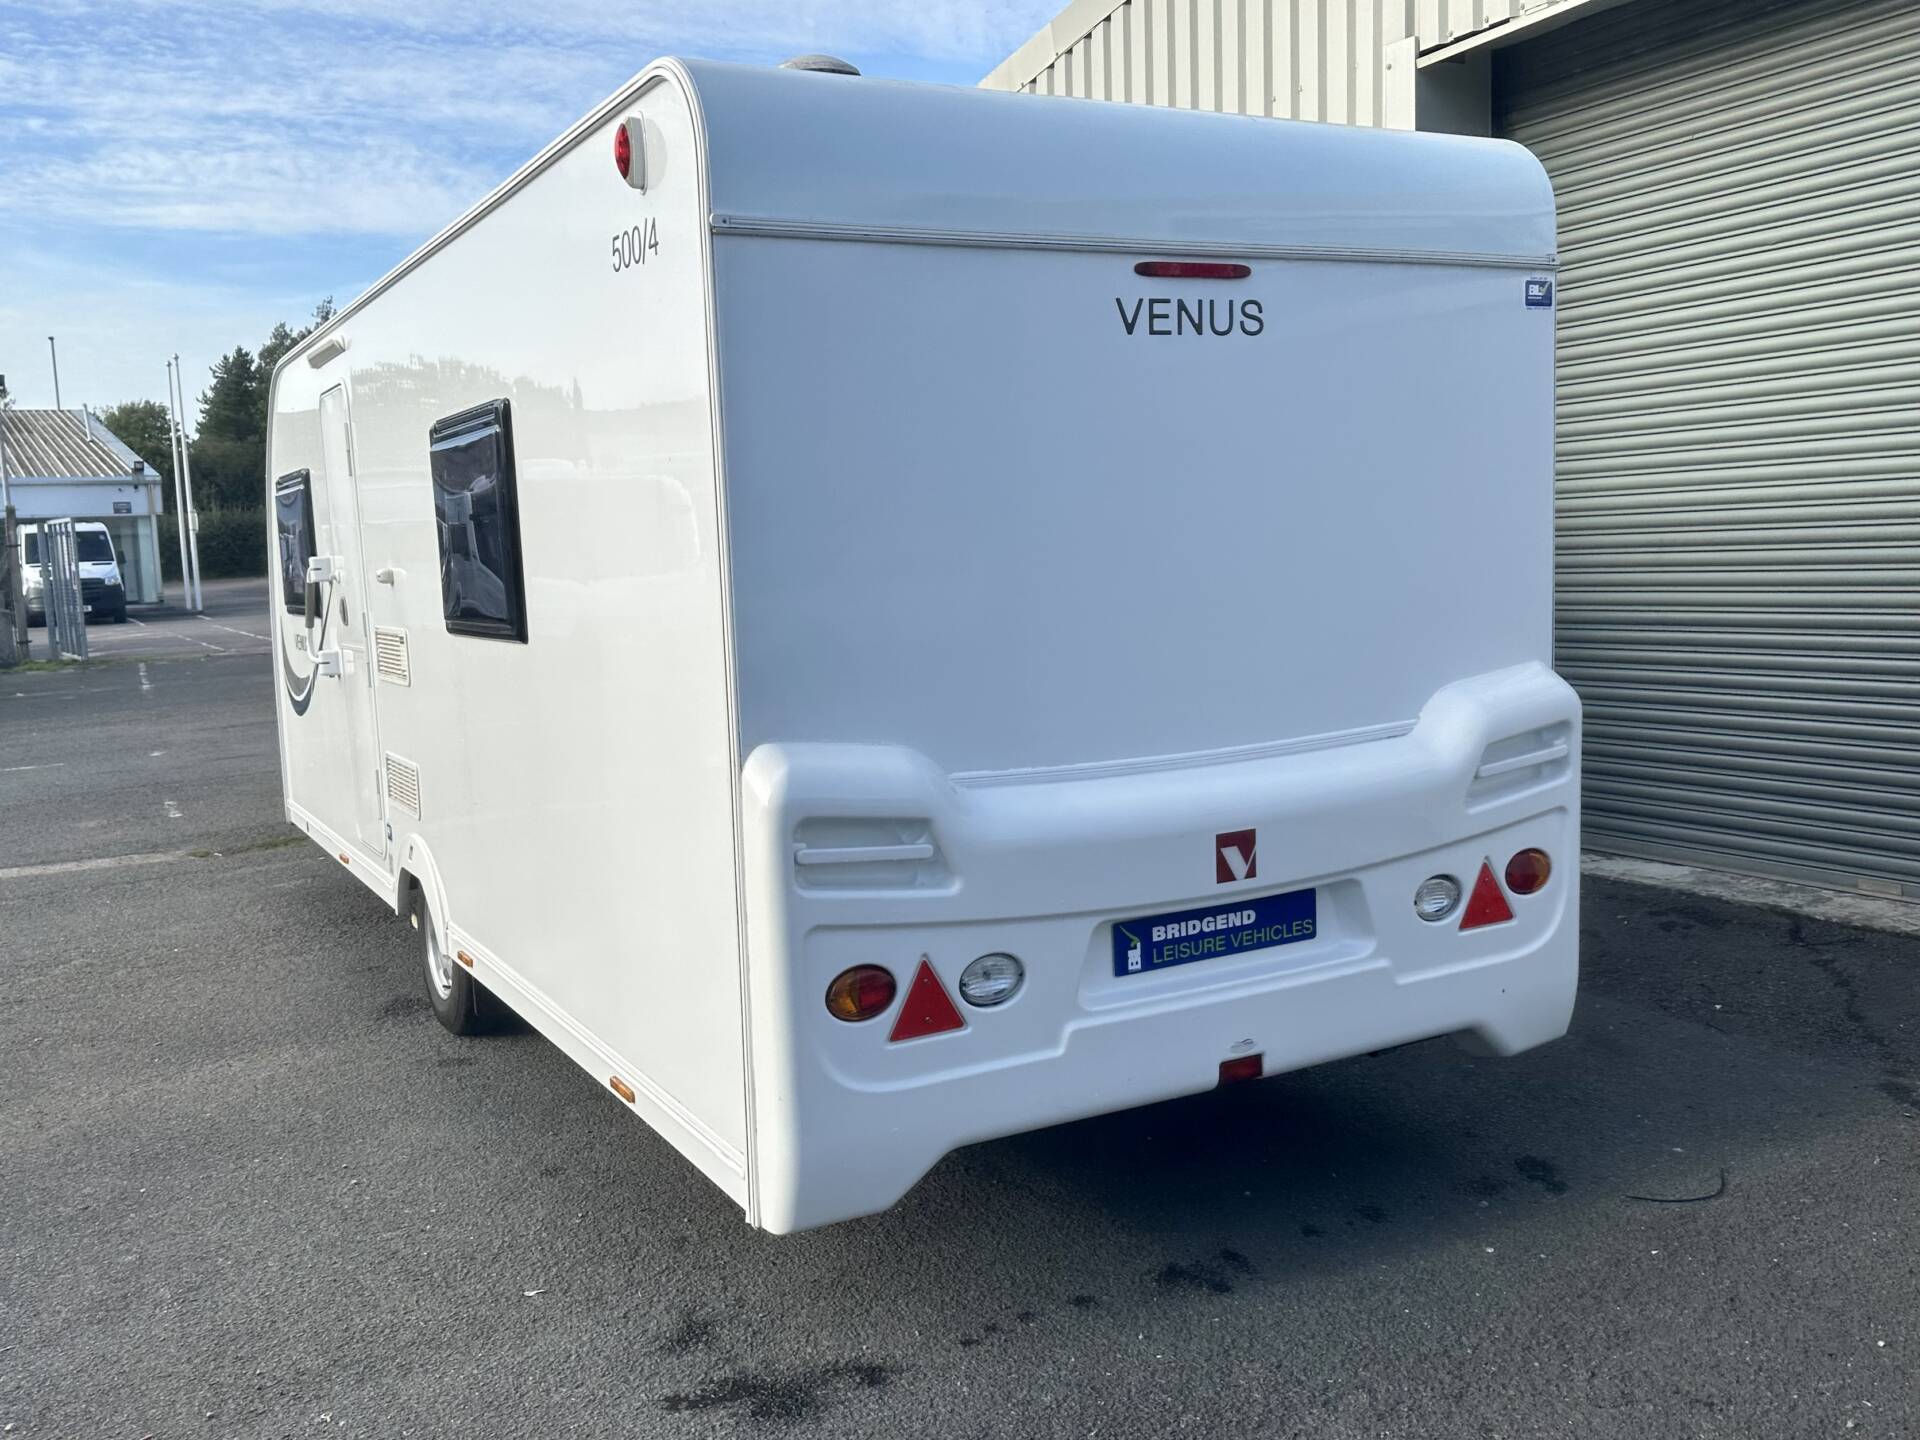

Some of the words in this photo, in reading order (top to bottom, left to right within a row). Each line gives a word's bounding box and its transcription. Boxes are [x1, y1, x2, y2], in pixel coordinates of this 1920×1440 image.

[612, 217, 659, 272] 500/4
[1115, 297, 1264, 336] VENUS
[1152, 909, 1257, 942] BRIDGEND
[1152, 935, 1226, 964] LEISURE
[1231, 919, 1313, 948] VEHICLES
